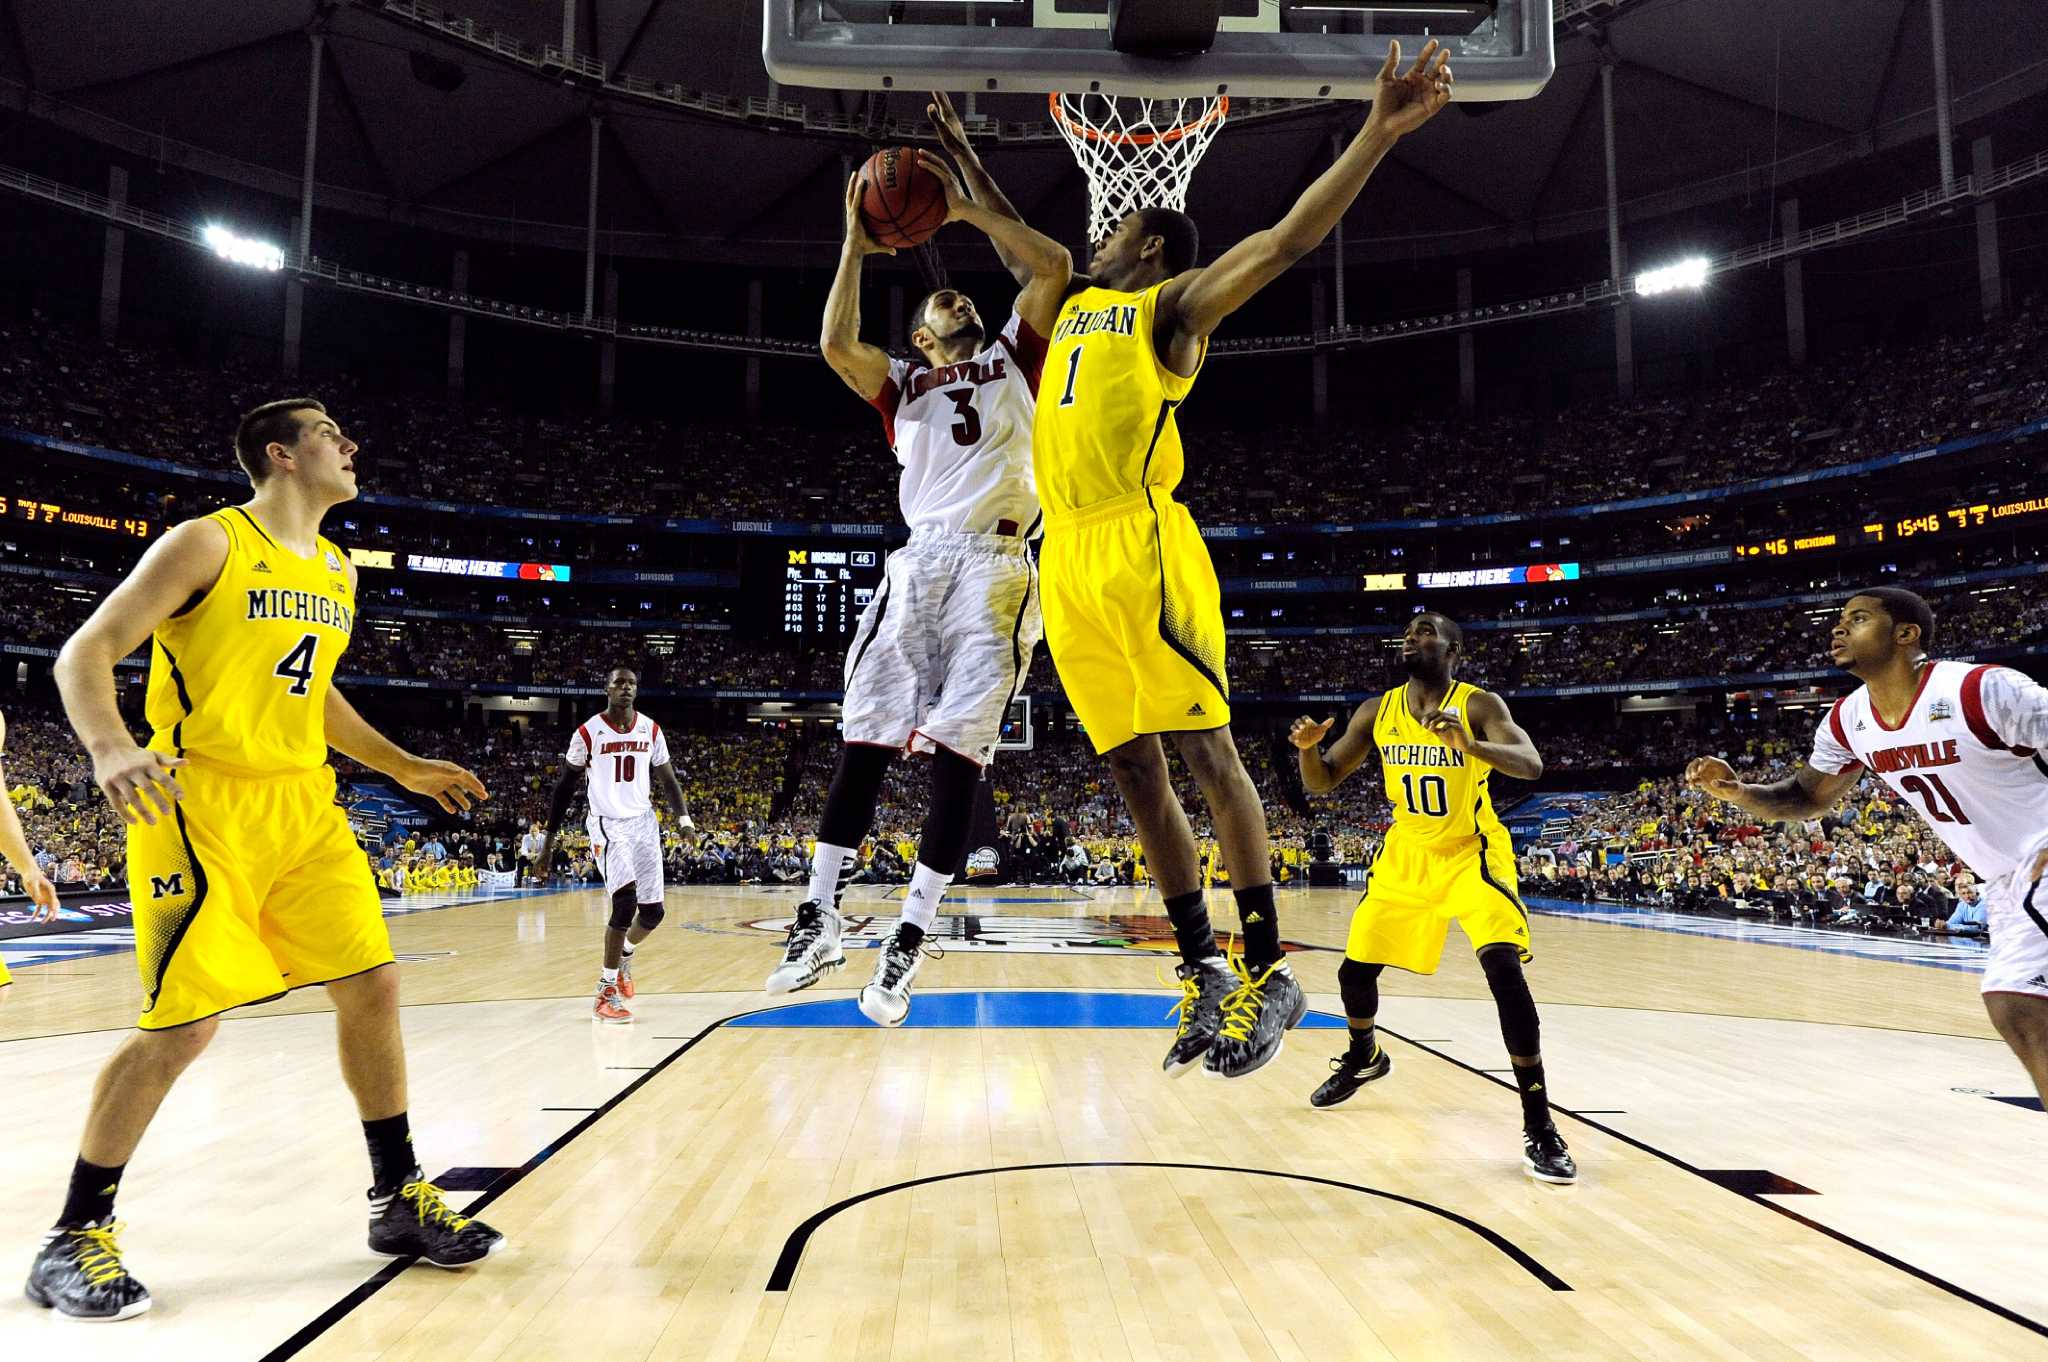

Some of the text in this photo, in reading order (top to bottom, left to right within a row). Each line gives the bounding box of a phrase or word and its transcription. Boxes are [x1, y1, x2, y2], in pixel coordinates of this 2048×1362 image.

[1060, 345, 1084, 407] 1
[943, 387, 983, 447] 3
[27, 508, 54, 523] 3 2
[1958, 515, 1967, 528] 3
[1976, 513, 1985, 525] 2
[62, 511, 147, 537] LOUISVILLE 43
[732, 521, 773, 532] LOUISVILLE
[831, 523, 884, 535] WICHITA STATE
[1200, 526, 1238, 537] SYRACUSE
[1897, 515, 1940, 536] 15:46
[1736, 534, 1836, 556] 4 46 MICHIGAN
[788, 550, 870, 564] M MICHIGAN 46
[407, 554, 423, 568] THE
[441, 558, 468, 575] ENDS
[468, 560, 505, 577] HERE
[640, 573, 674, 582] DIVISIONS
[1254, 581, 1297, 589] ASSOCIATION
[1417, 573, 1432, 585] THE
[1449, 570, 1475, 587] ENDS
[1475, 568, 1513, 586] HERE
[818, 584, 824, 592] 7
[816, 594, 826, 602] 17
[246, 587, 352, 635] MICHIGAN
[816, 604, 826, 612] 10
[818, 614, 824, 622] 6
[818, 624, 824, 632] 3
[4, 643, 49, 657] CELEBRATING
[117, 657, 145, 667] ADNESS
[272, 631, 320, 697] 4
[388, 678, 429, 688] NCAA.com
[517, 686, 553, 694] CELEBRATING
[1556, 687, 1592, 697] CELEBRATING
[600, 740, 650, 755] LOUISVILLE
[1381, 743, 1465, 768] MICHIGAN
[1865, 738, 1961, 774] LOUISVILLE
[613, 754, 636, 783] 10
[1401, 772, 1449, 818] 10
[1900, 772, 1972, 825] 21
[151, 872, 185, 899] M
